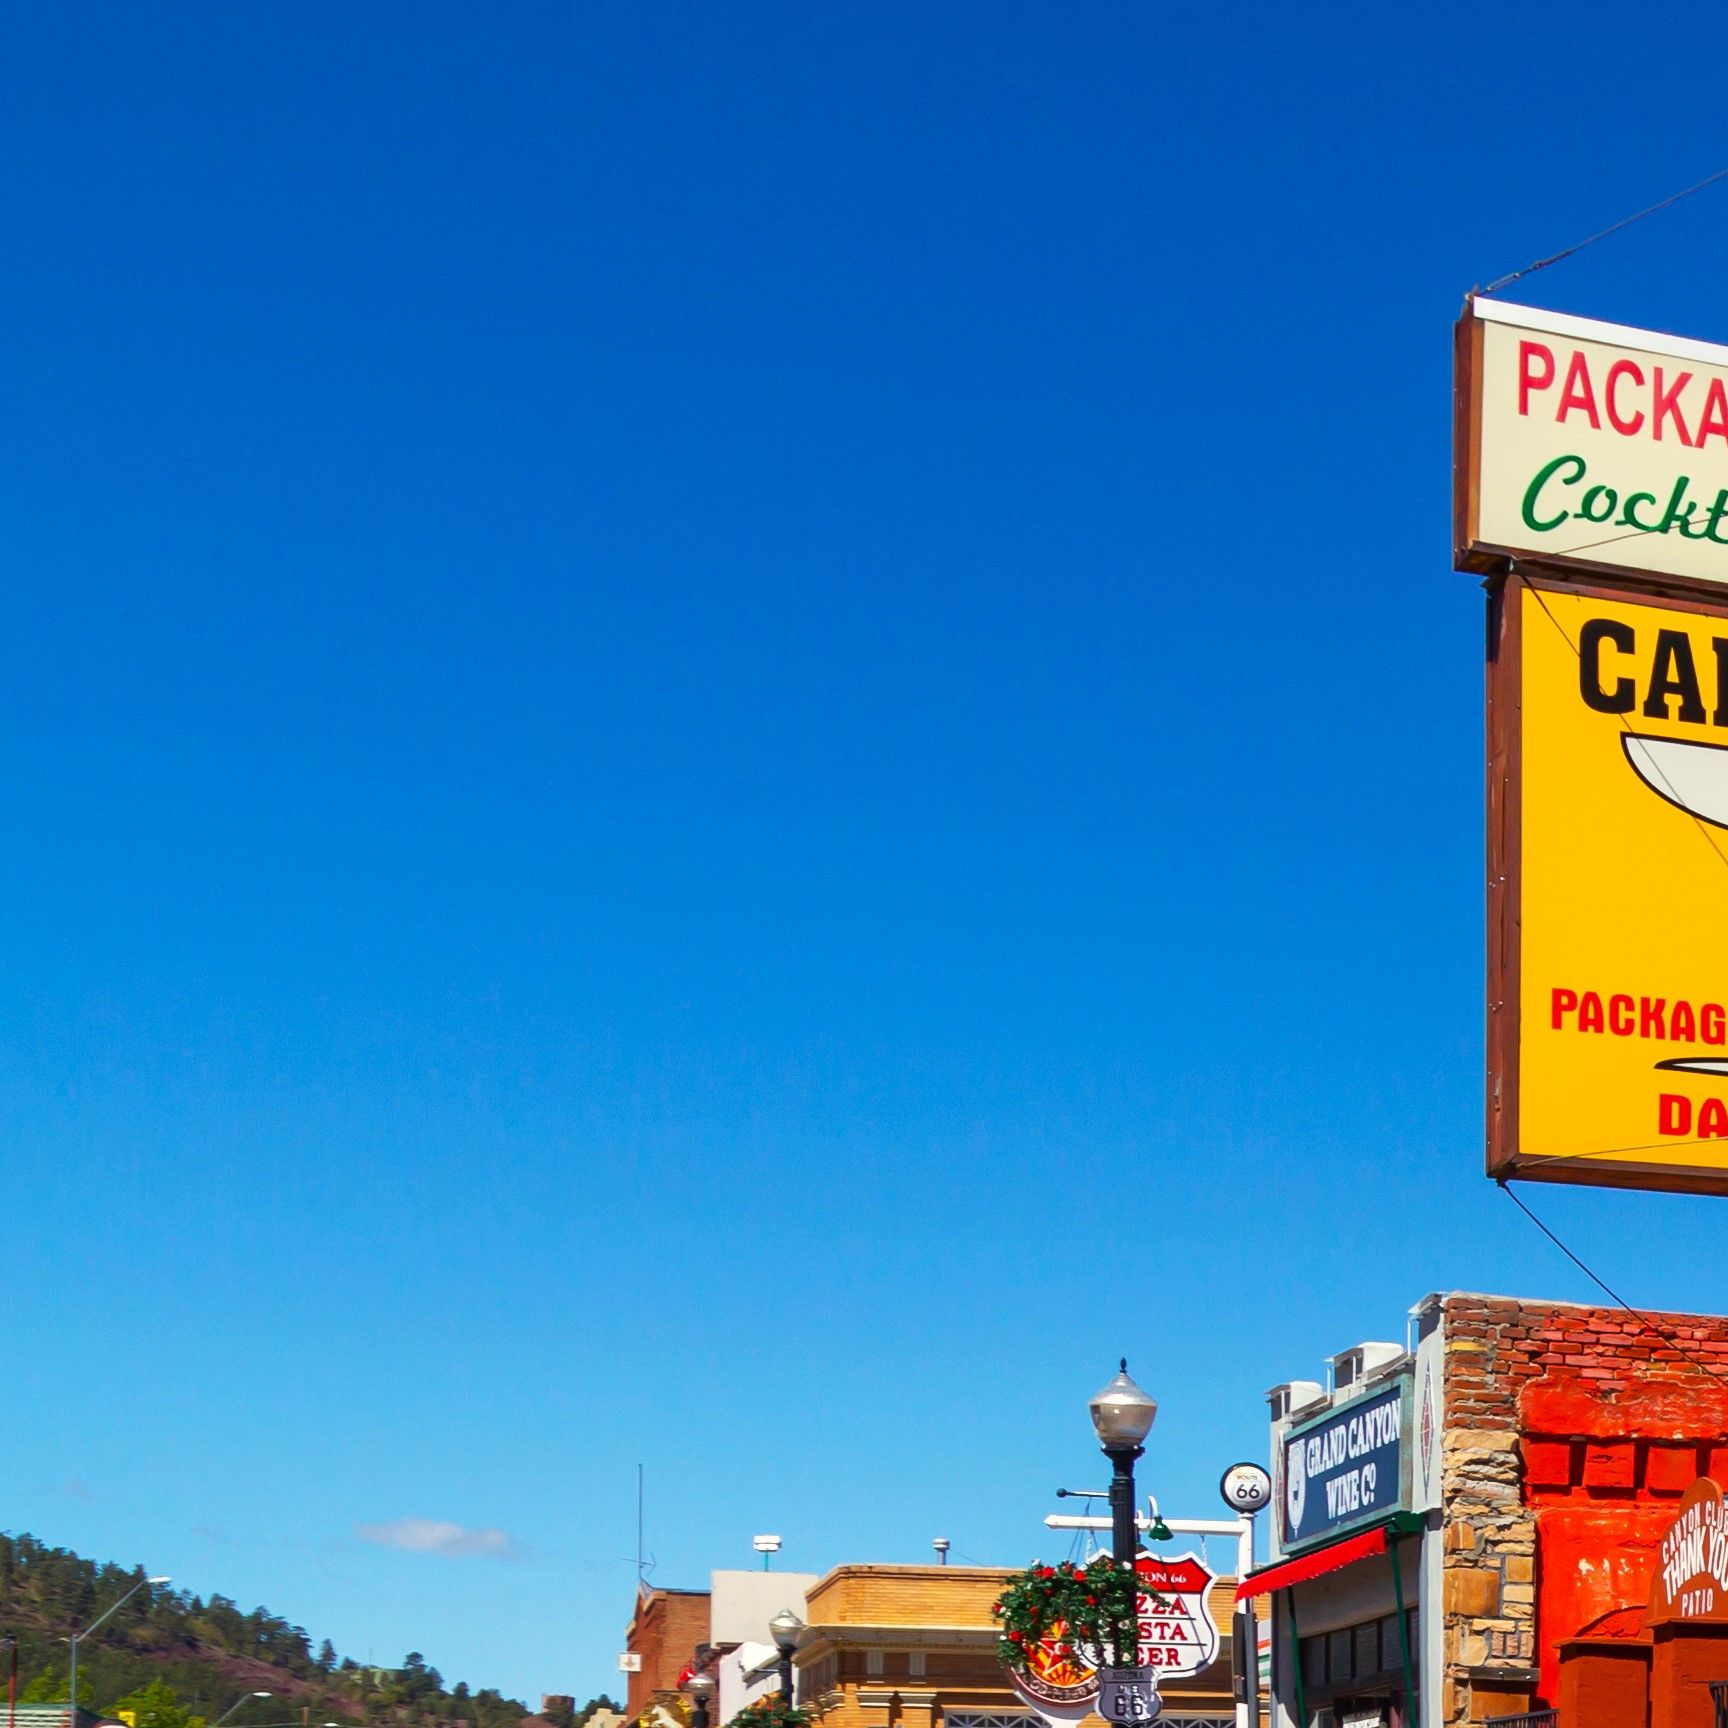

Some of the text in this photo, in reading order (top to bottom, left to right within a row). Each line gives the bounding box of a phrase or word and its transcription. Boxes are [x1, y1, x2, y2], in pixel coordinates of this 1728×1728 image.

[1306, 1397, 1402, 1478] GRAND CANYON
[1236, 1483, 1261, 1500] 66
[1325, 1468, 1360, 1520] WINE
[1662, 1501, 1701, 1565] CANYON
[1662, 1524, 1707, 1606] THANK
[1681, 1587, 1714, 1618] PATIO
[1114, 1694, 1144, 1717] 66
